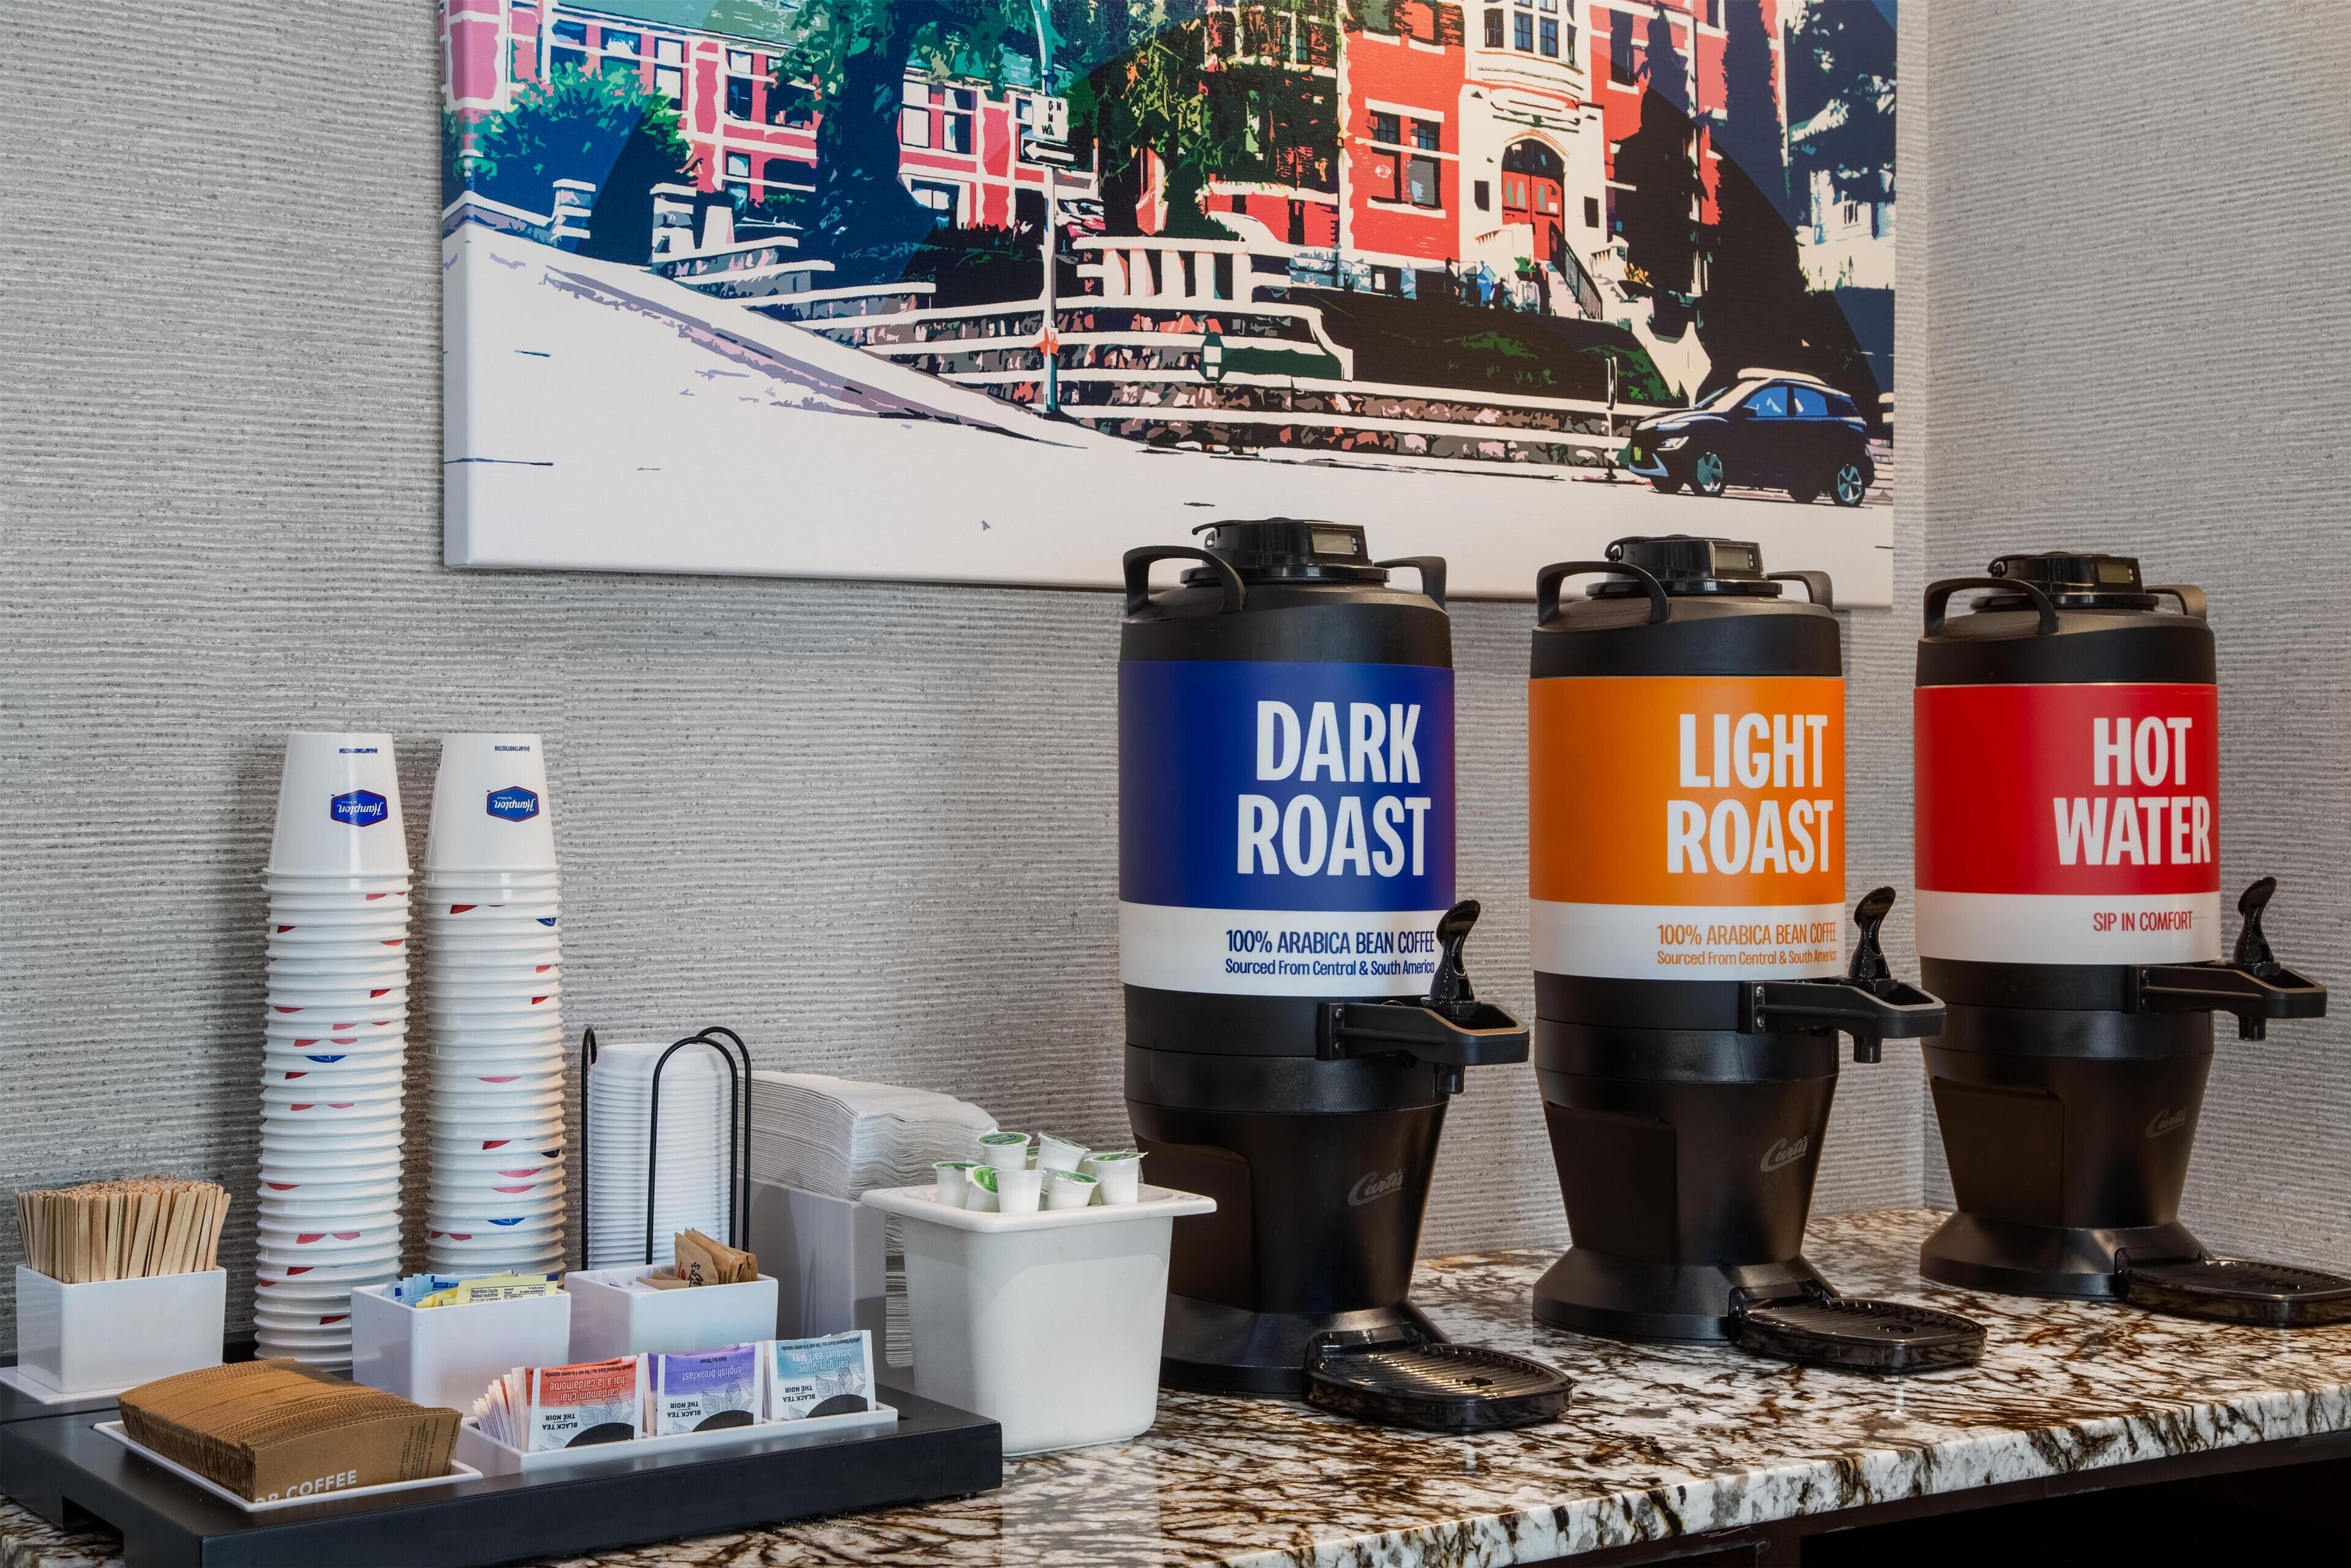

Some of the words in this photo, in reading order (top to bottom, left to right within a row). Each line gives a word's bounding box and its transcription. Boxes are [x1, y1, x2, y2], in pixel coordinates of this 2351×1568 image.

[1256, 701, 1422, 784] DARK
[1679, 713, 1828, 788] LIGHT
[2093, 716, 2192, 786] HOT
[337, 801, 384, 816] Hampton
[493, 798, 536, 812] Hampton
[1237, 795, 1432, 877] ROAST
[1667, 799, 1833, 874] ROAST
[2053, 796, 2211, 866] WATER
[2093, 912, 2117, 932] SIP
[2121, 912, 2135, 931] IN
[2140, 910, 2193, 931] COMFORT
[1657, 924, 1702, 945] 100%
[1706, 925, 1771, 945] ARABICA
[1776, 923, 1807, 945] BEAN
[1810, 921, 1837, 943] COFFEE
[1226, 929, 1273, 953] 100%
[1277, 931, 1351, 954] ARABICA
[1356, 932, 1394, 954] BEAN
[1398, 931, 1434, 954] COFFEE
[1657, 950, 1705, 965] Sourced
[1708, 951, 1736, 965] From
[1739, 950, 1777, 965] Central
[1779, 950, 1787, 964] &
[1789, 949, 1812, 964] South
[1813, 948, 1837, 962] America
[1226, 958, 1275, 975] Sourced
[1279, 960, 1310, 975] From
[1313, 960, 1356, 975] Central
[1359, 960, 1368, 975] &
[1371, 960, 1401, 975] South
[1403, 959, 1434, 975] America
[1760, 1136, 1808, 1172] Curtis
[1348, 1169, 1403, 1206] Curtis
[792, 1352, 806, 1362] grey
[809, 1352, 823, 1362] earl
[825, 1348, 852, 1359] bosquet
[718, 1364, 741, 1379] english
[798, 1362, 817, 1374] grove
[819, 1360, 833, 1371] grey
[836, 1360, 848, 1371] earl
[598, 1378, 605, 1388] la
[607, 1378, 612, 1387] à
[614, 1375, 629, 1387] chai
[681, 1370, 715, 1382] breakfast
[549, 1379, 595, 1392] cardamome
[801, 1385, 812, 1394] THÉ
[560, 1392, 577, 1405] chai
[579, 1388, 619, 1401] cardamom
[687, 1401, 699, 1409] THÉ
[286, 1469, 357, 1500] COFFEE
